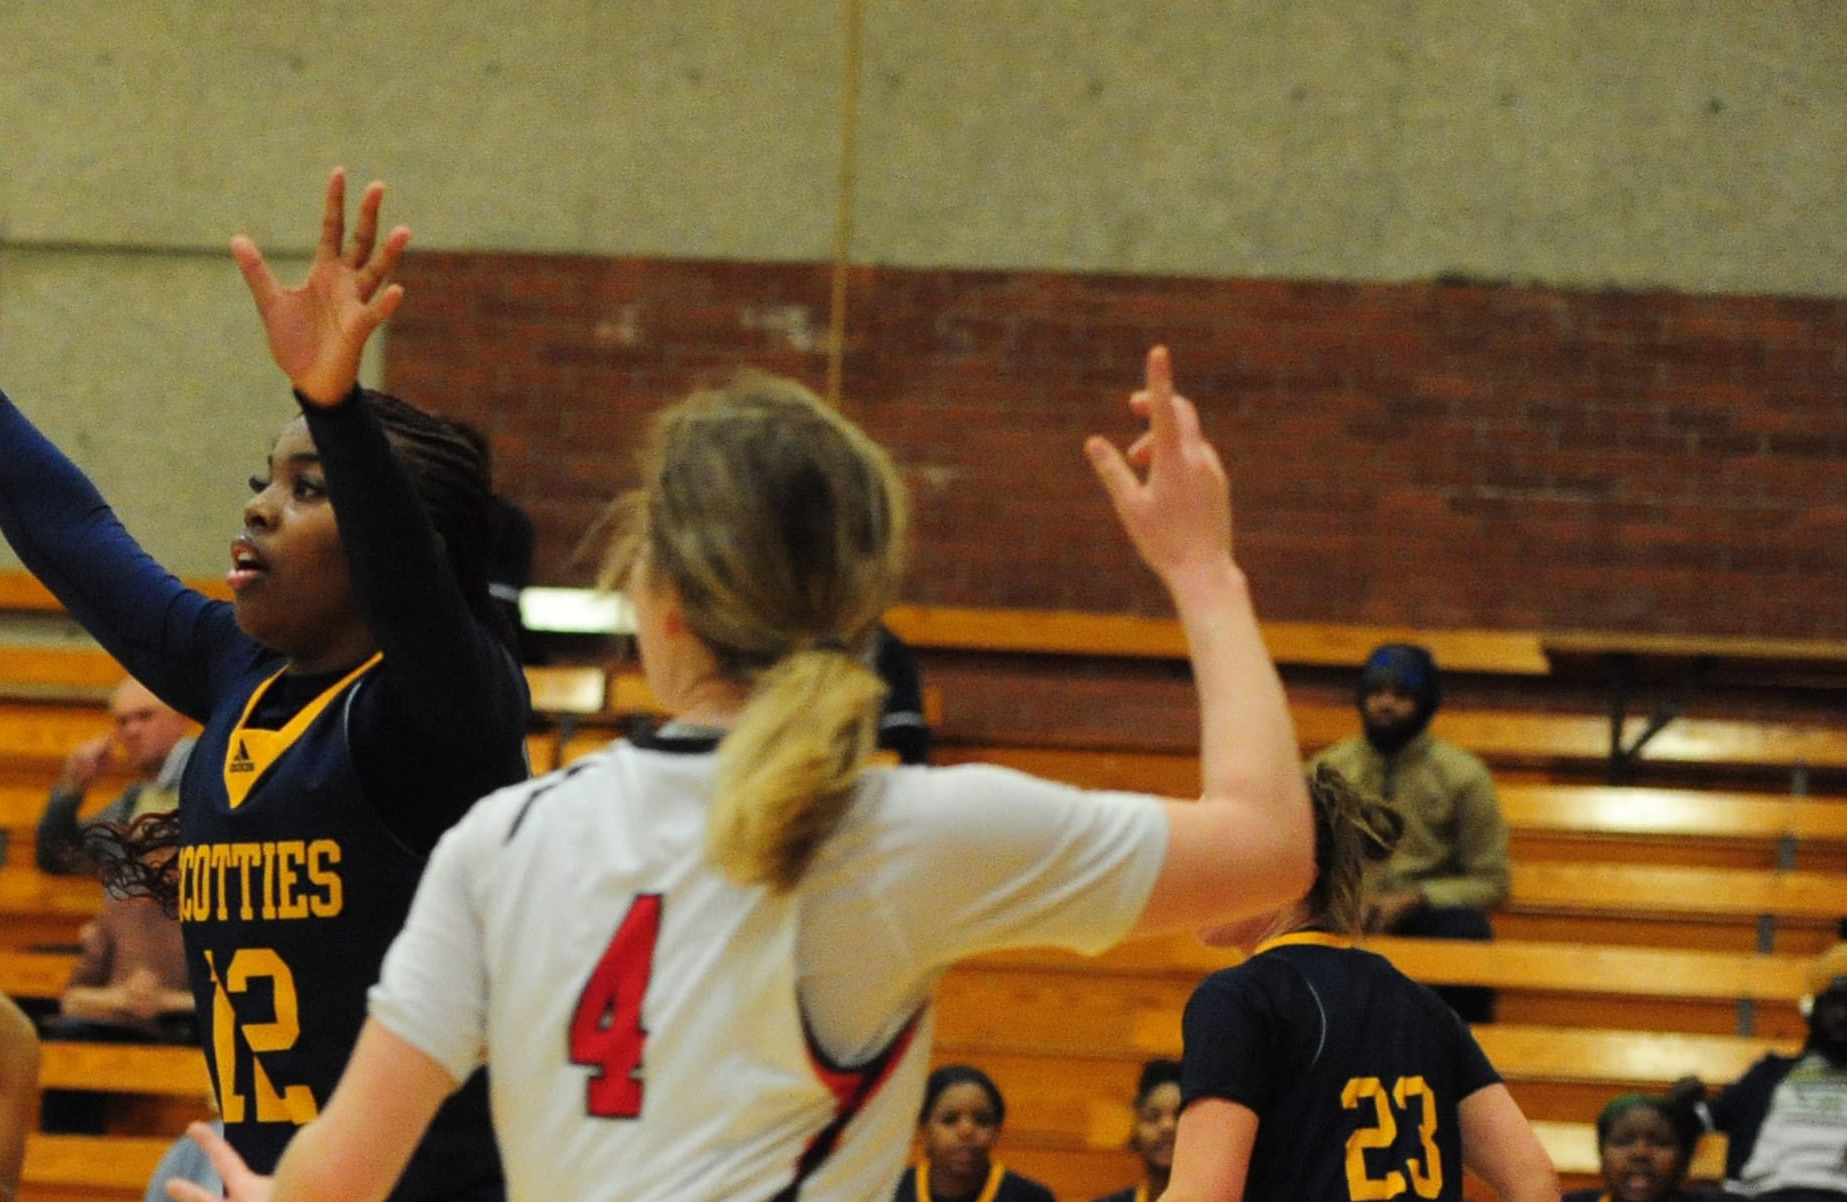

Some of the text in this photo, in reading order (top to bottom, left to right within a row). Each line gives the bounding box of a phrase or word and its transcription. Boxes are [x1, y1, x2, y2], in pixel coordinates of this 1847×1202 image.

[204, 947, 320, 1125] 12
[567, 892, 664, 1119] 4
[1340, 1076, 1443, 1202] 23
